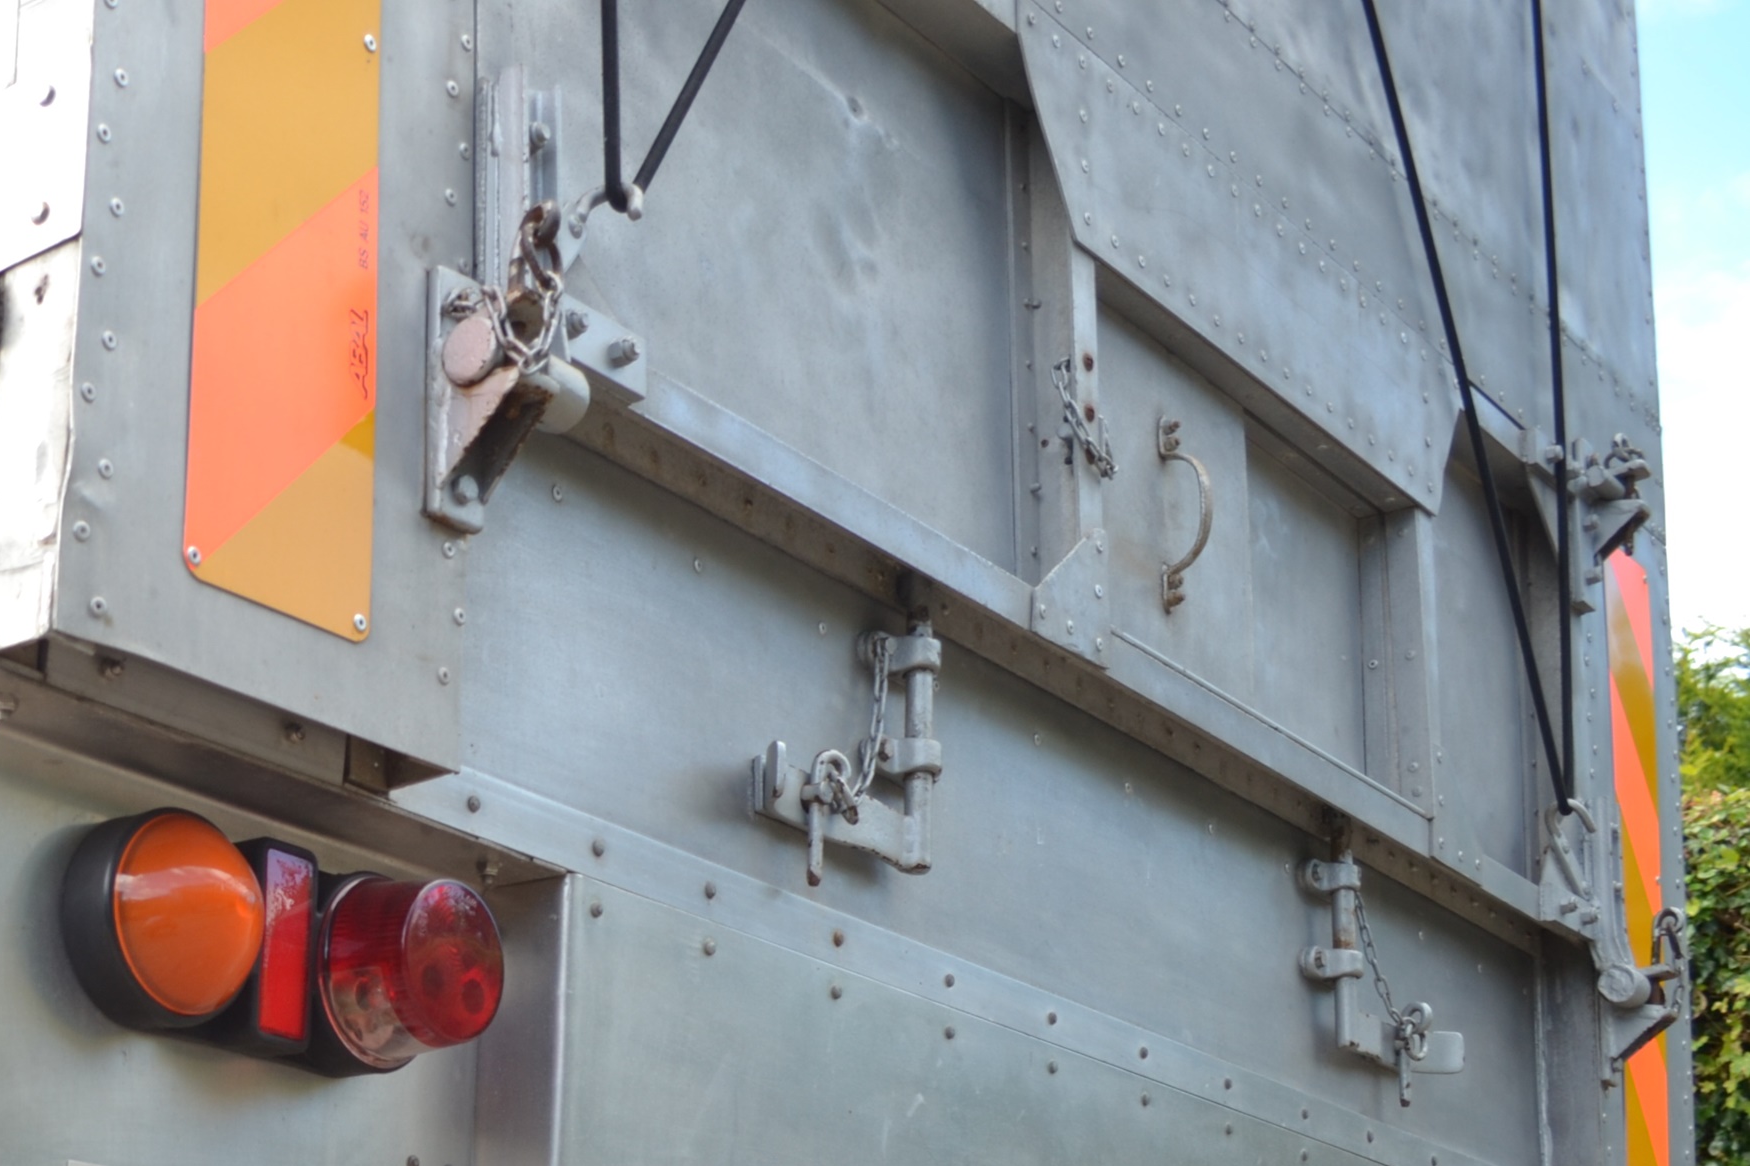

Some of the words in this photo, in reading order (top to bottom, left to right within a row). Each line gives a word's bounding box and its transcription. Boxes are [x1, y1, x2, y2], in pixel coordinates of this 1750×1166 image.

[359, 189, 370, 214] 152
[359, 220, 369, 244] AU
[358, 247, 369, 269] BS
